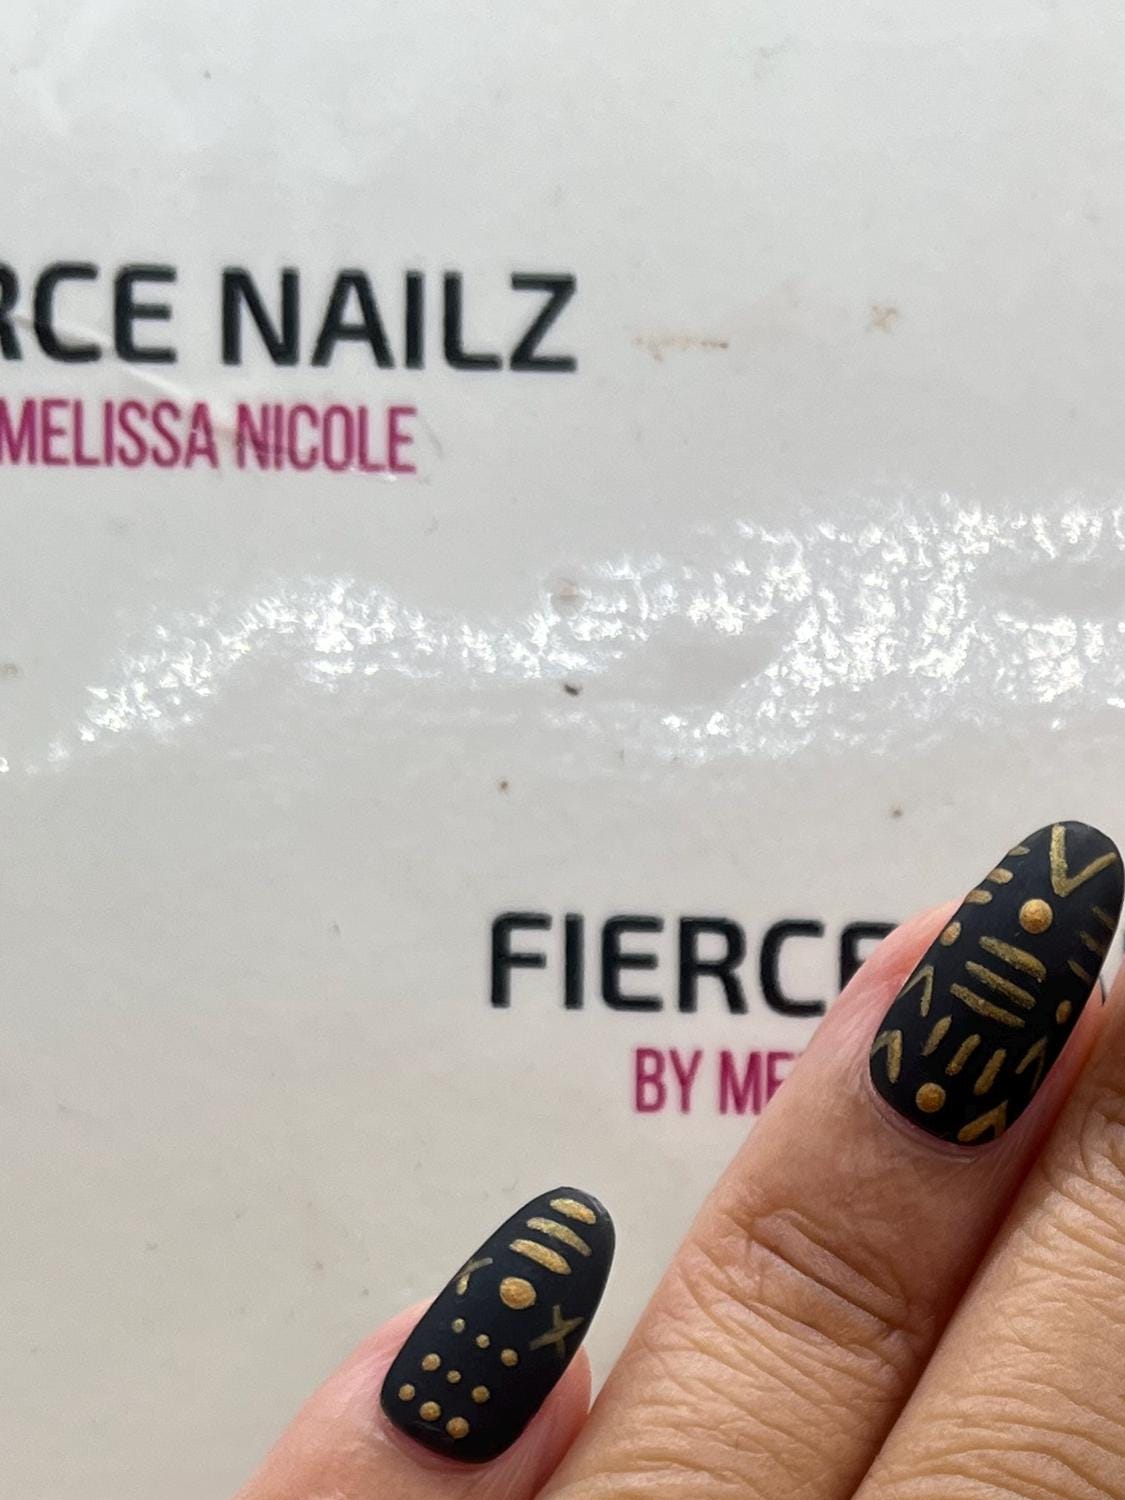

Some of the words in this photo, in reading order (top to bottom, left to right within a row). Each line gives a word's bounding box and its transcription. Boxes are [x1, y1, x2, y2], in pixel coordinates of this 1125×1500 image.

[222, 268, 576, 374] NAILZ
[0, 398, 220, 470] MELISSA
[235, 404, 417, 475] NICOLE
[634, 1047, 705, 1115] BY
